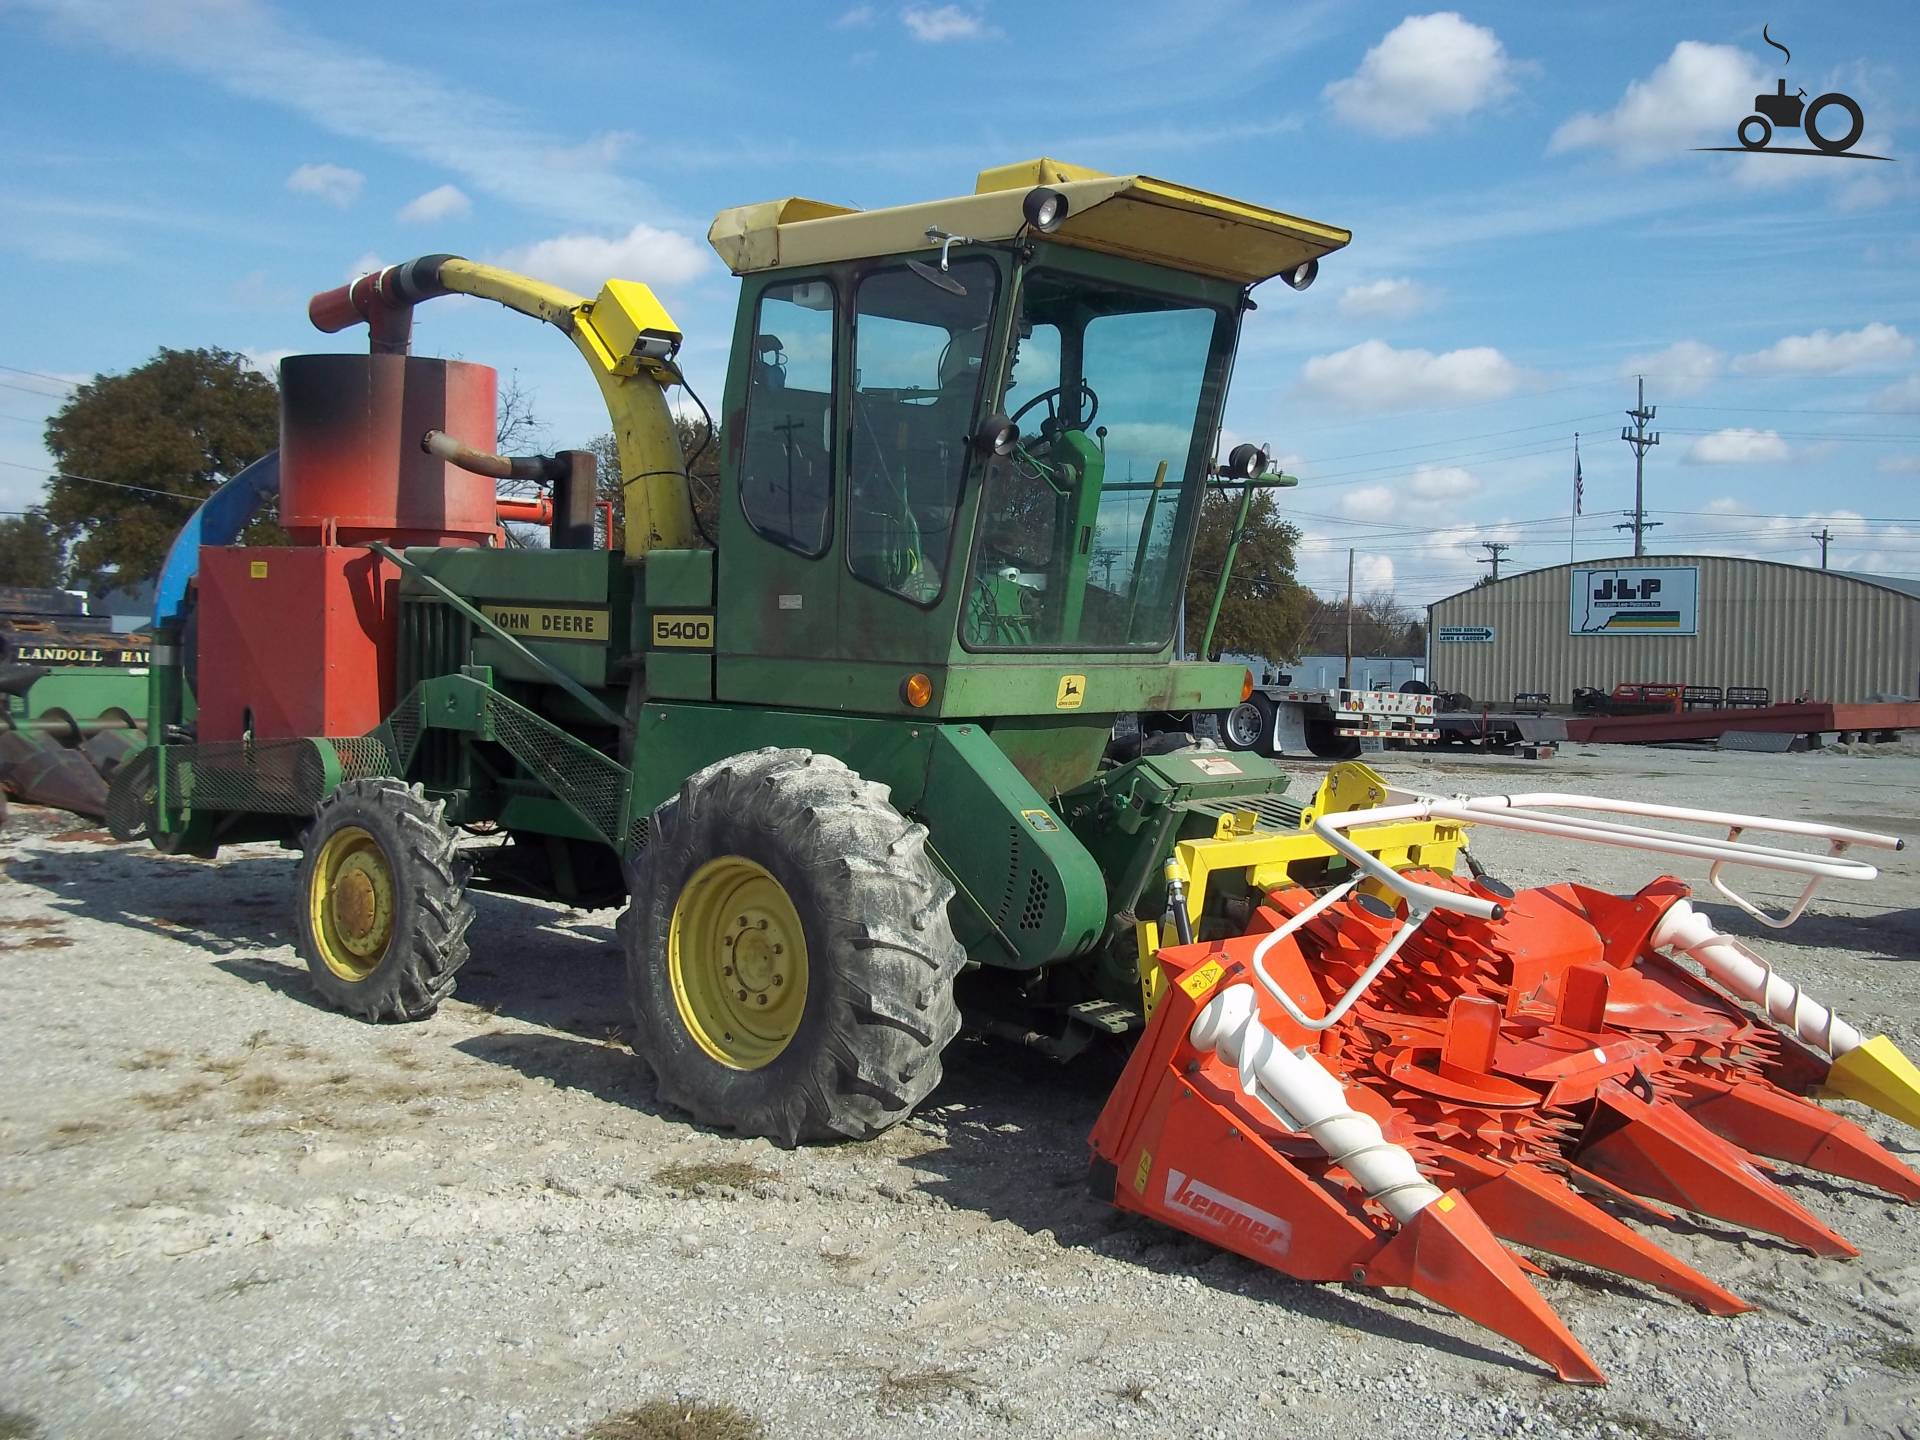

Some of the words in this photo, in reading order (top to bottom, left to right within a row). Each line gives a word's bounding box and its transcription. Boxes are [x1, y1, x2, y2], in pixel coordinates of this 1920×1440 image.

[542, 614, 594, 633] DEERE
[656, 622, 710, 640] 5400
[18, 647, 103, 662] LANDOLL
